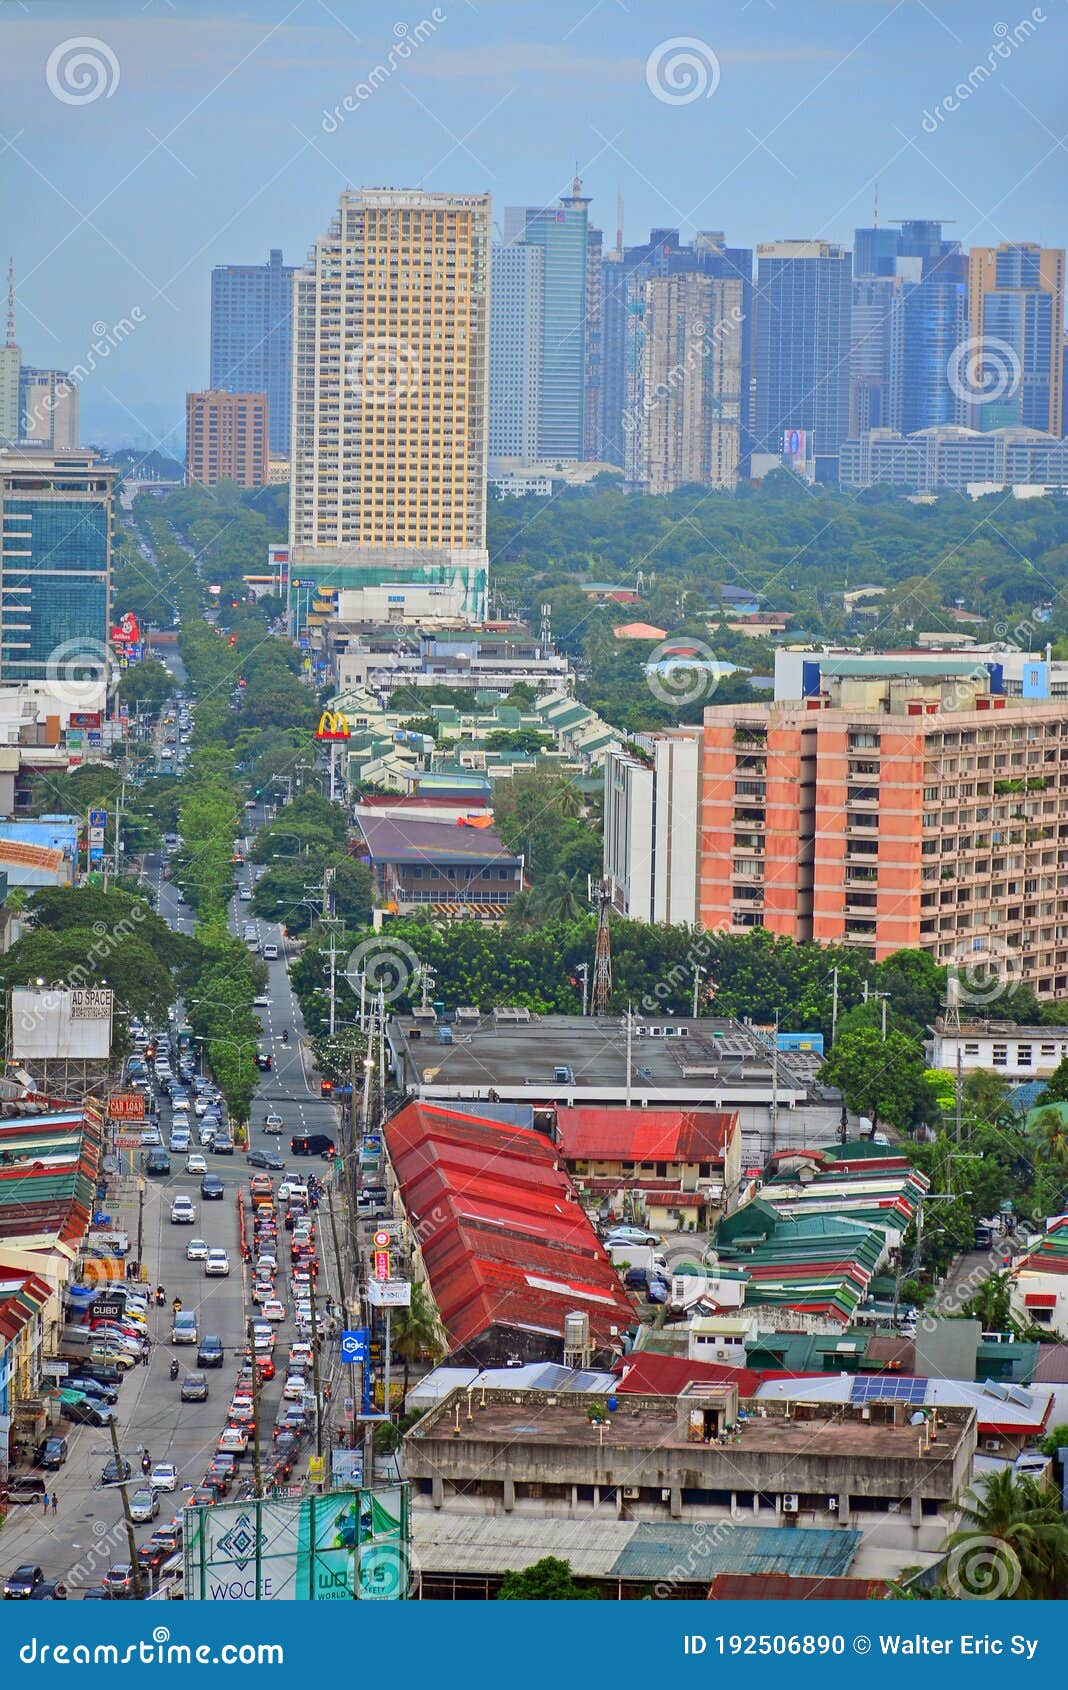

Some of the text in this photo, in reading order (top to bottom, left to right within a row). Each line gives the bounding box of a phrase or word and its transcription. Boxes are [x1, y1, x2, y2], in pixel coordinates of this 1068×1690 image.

[72, 991, 110, 1005] AD SPACE
[111, 1102, 144, 1112] CAR LOAN
[93, 1306, 118, 1314] CUBO
[317, 1590, 346, 1600] WORLD
